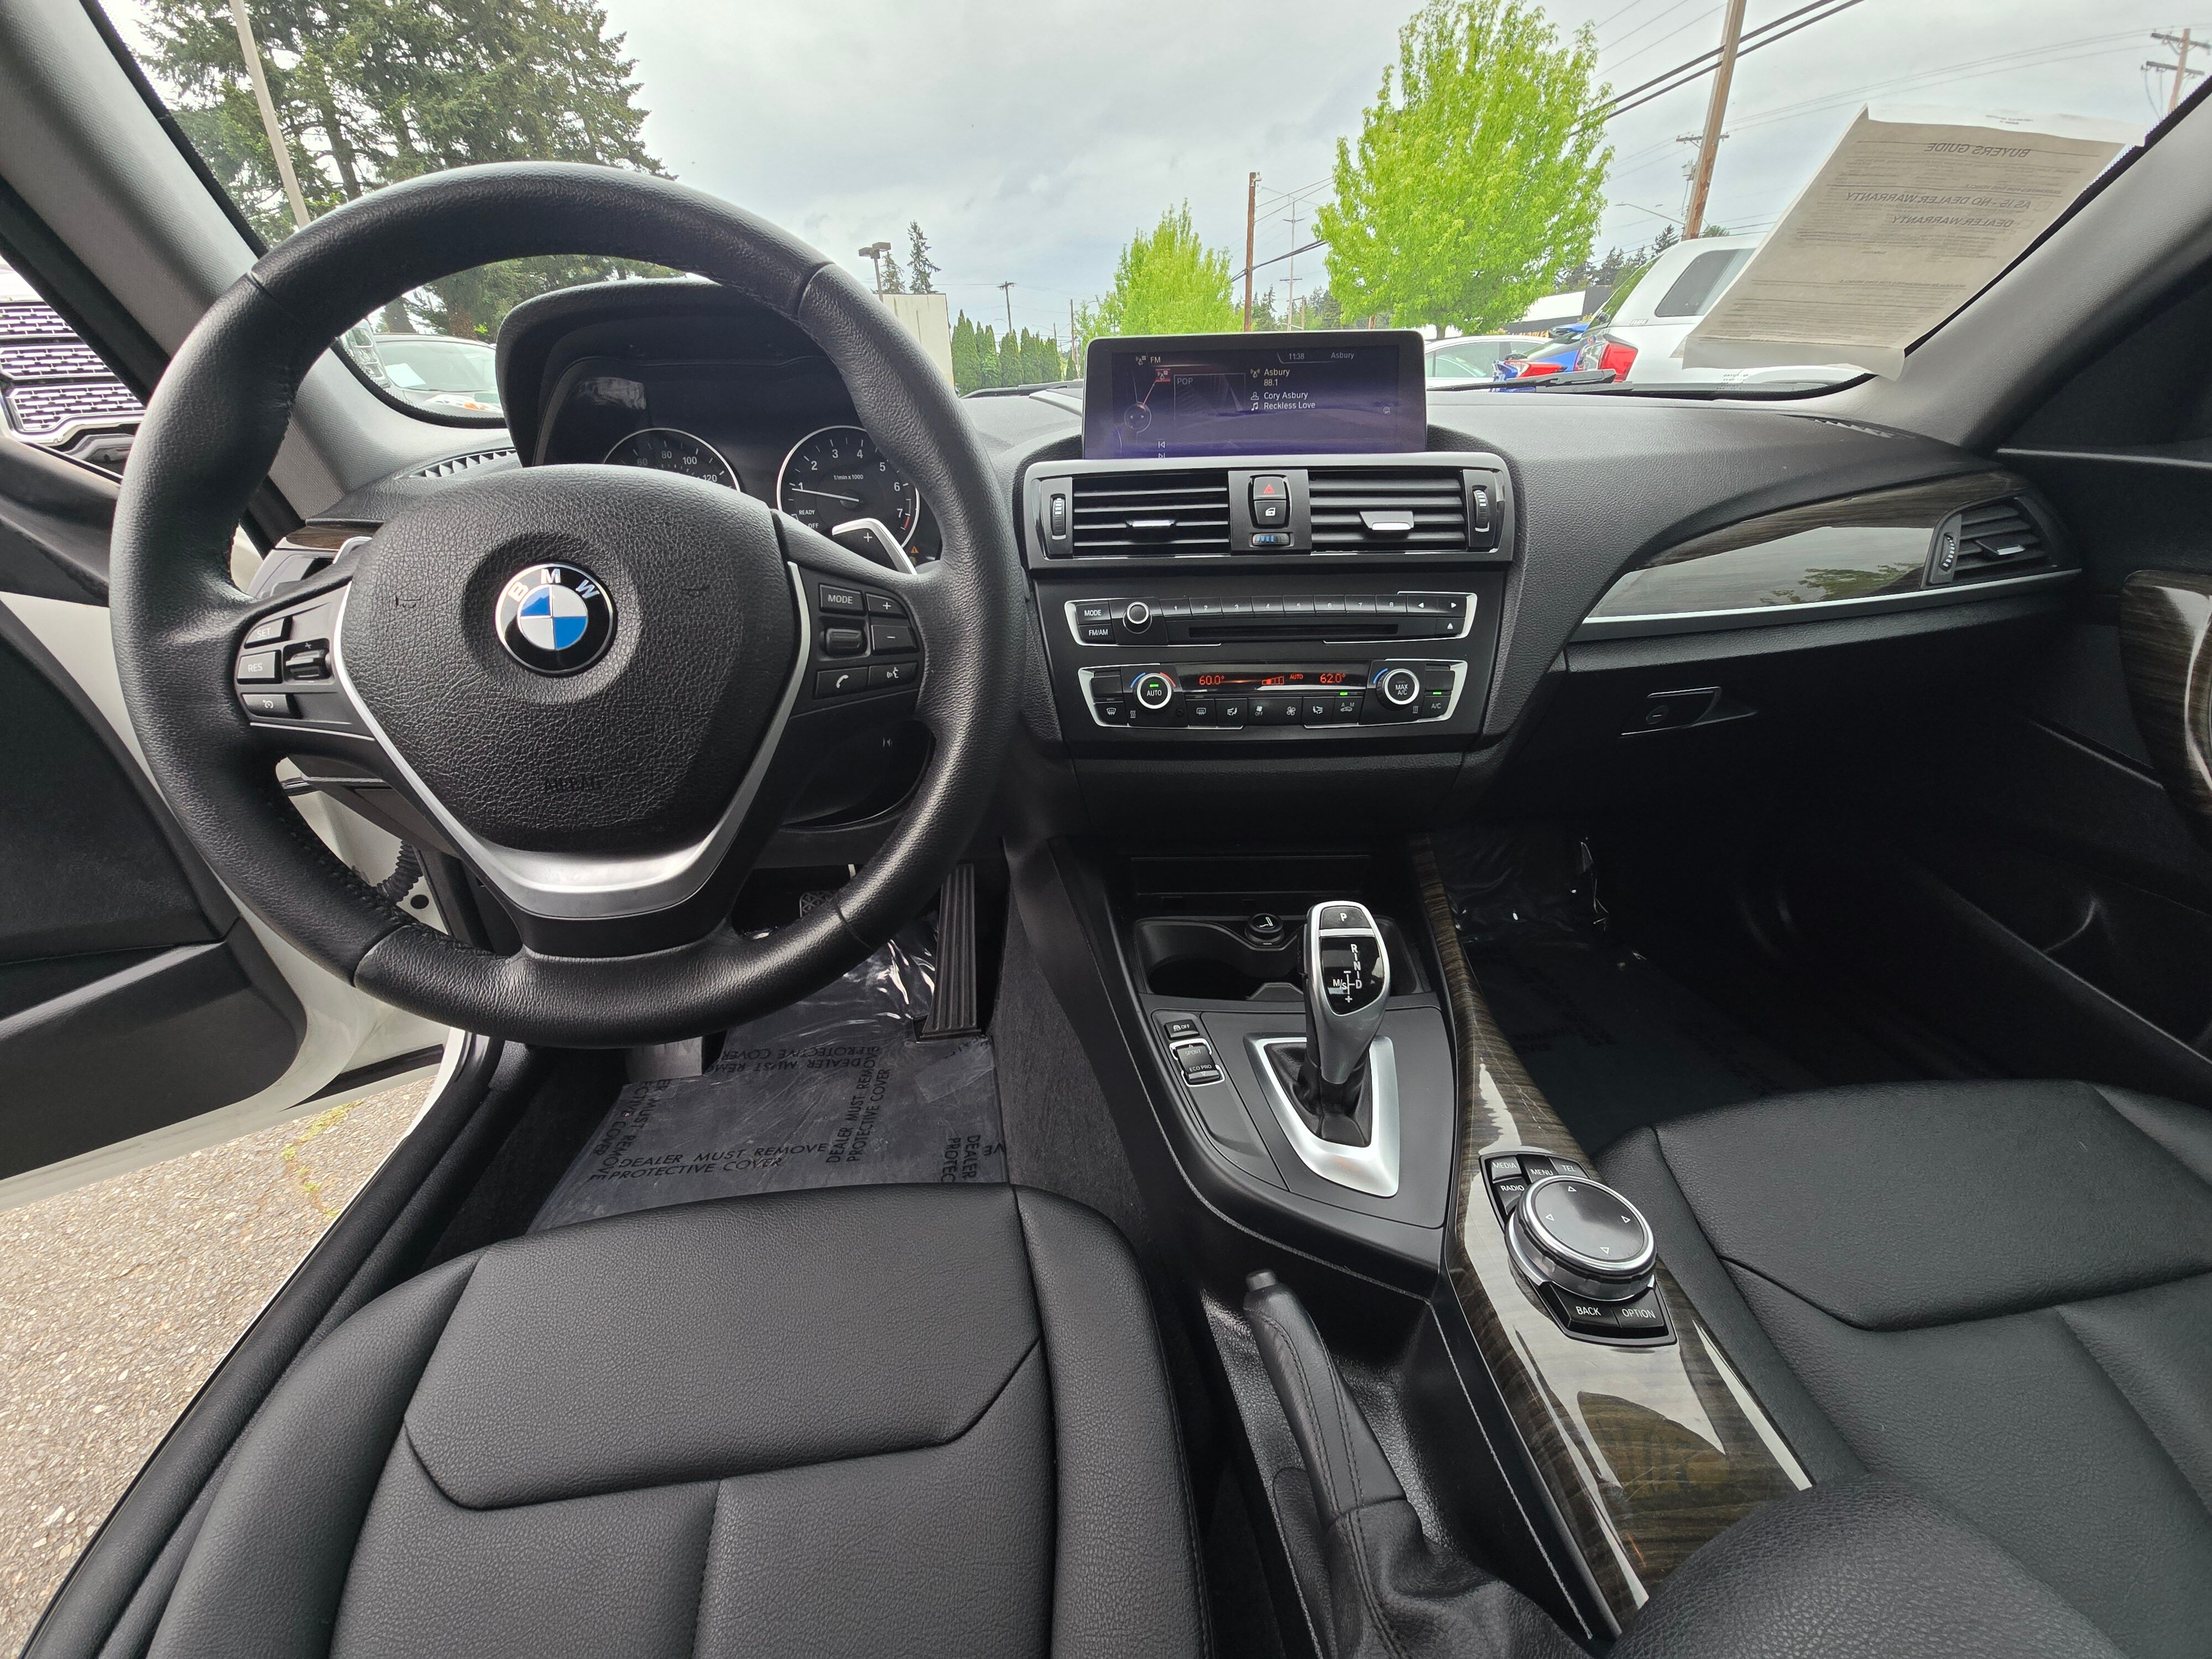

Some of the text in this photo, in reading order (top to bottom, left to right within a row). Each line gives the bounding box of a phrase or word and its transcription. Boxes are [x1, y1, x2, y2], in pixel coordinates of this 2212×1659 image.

[1264, 369, 1290, 377] Asbury
[1264, 392, 1308, 400] Cory Asbury
[661, 451, 672, 459] 80
[832, 449, 838, 458] 3
[857, 449, 863, 458] 4
[682, 456, 697, 465] 100
[811, 461, 818, 470] 2
[879, 462, 885, 472] 5
[894, 482, 900, 492] 6
[896, 509, 903, 518] 7
[508, 568, 600, 602] BMW
[827, 594, 853, 604] MODE
[257, 627, 271, 638] SET
[248, 662, 263, 673] RES
[1340, 913, 1347, 921] P
[1350, 944, 1358, 953] R
[1354, 961, 1361, 971] N
[1333, 979, 1348, 990] M/S
[1356, 979, 1362, 989] D
[722, 1049, 770, 1060] COVER
[807, 1058, 860, 1068] DEALER
[846, 1069, 891, 1162] PROTECTIVE COVER
[826, 1127, 853, 1163] DEALER
[844, 1095, 865, 1121] MUST
[587, 1098, 660, 1180] MUST REMOVE
[593, 1121, 626, 1156] COVER
[619, 1143, 827, 1167] DEALER MUST REMOVE
[962, 1135, 980, 1178] DEALER
[608, 1157, 781, 1180] PROTECTIVE COVER
[1576, 1306, 1601, 1316] BACK
[1622, 1308, 1656, 1319] OPTION
